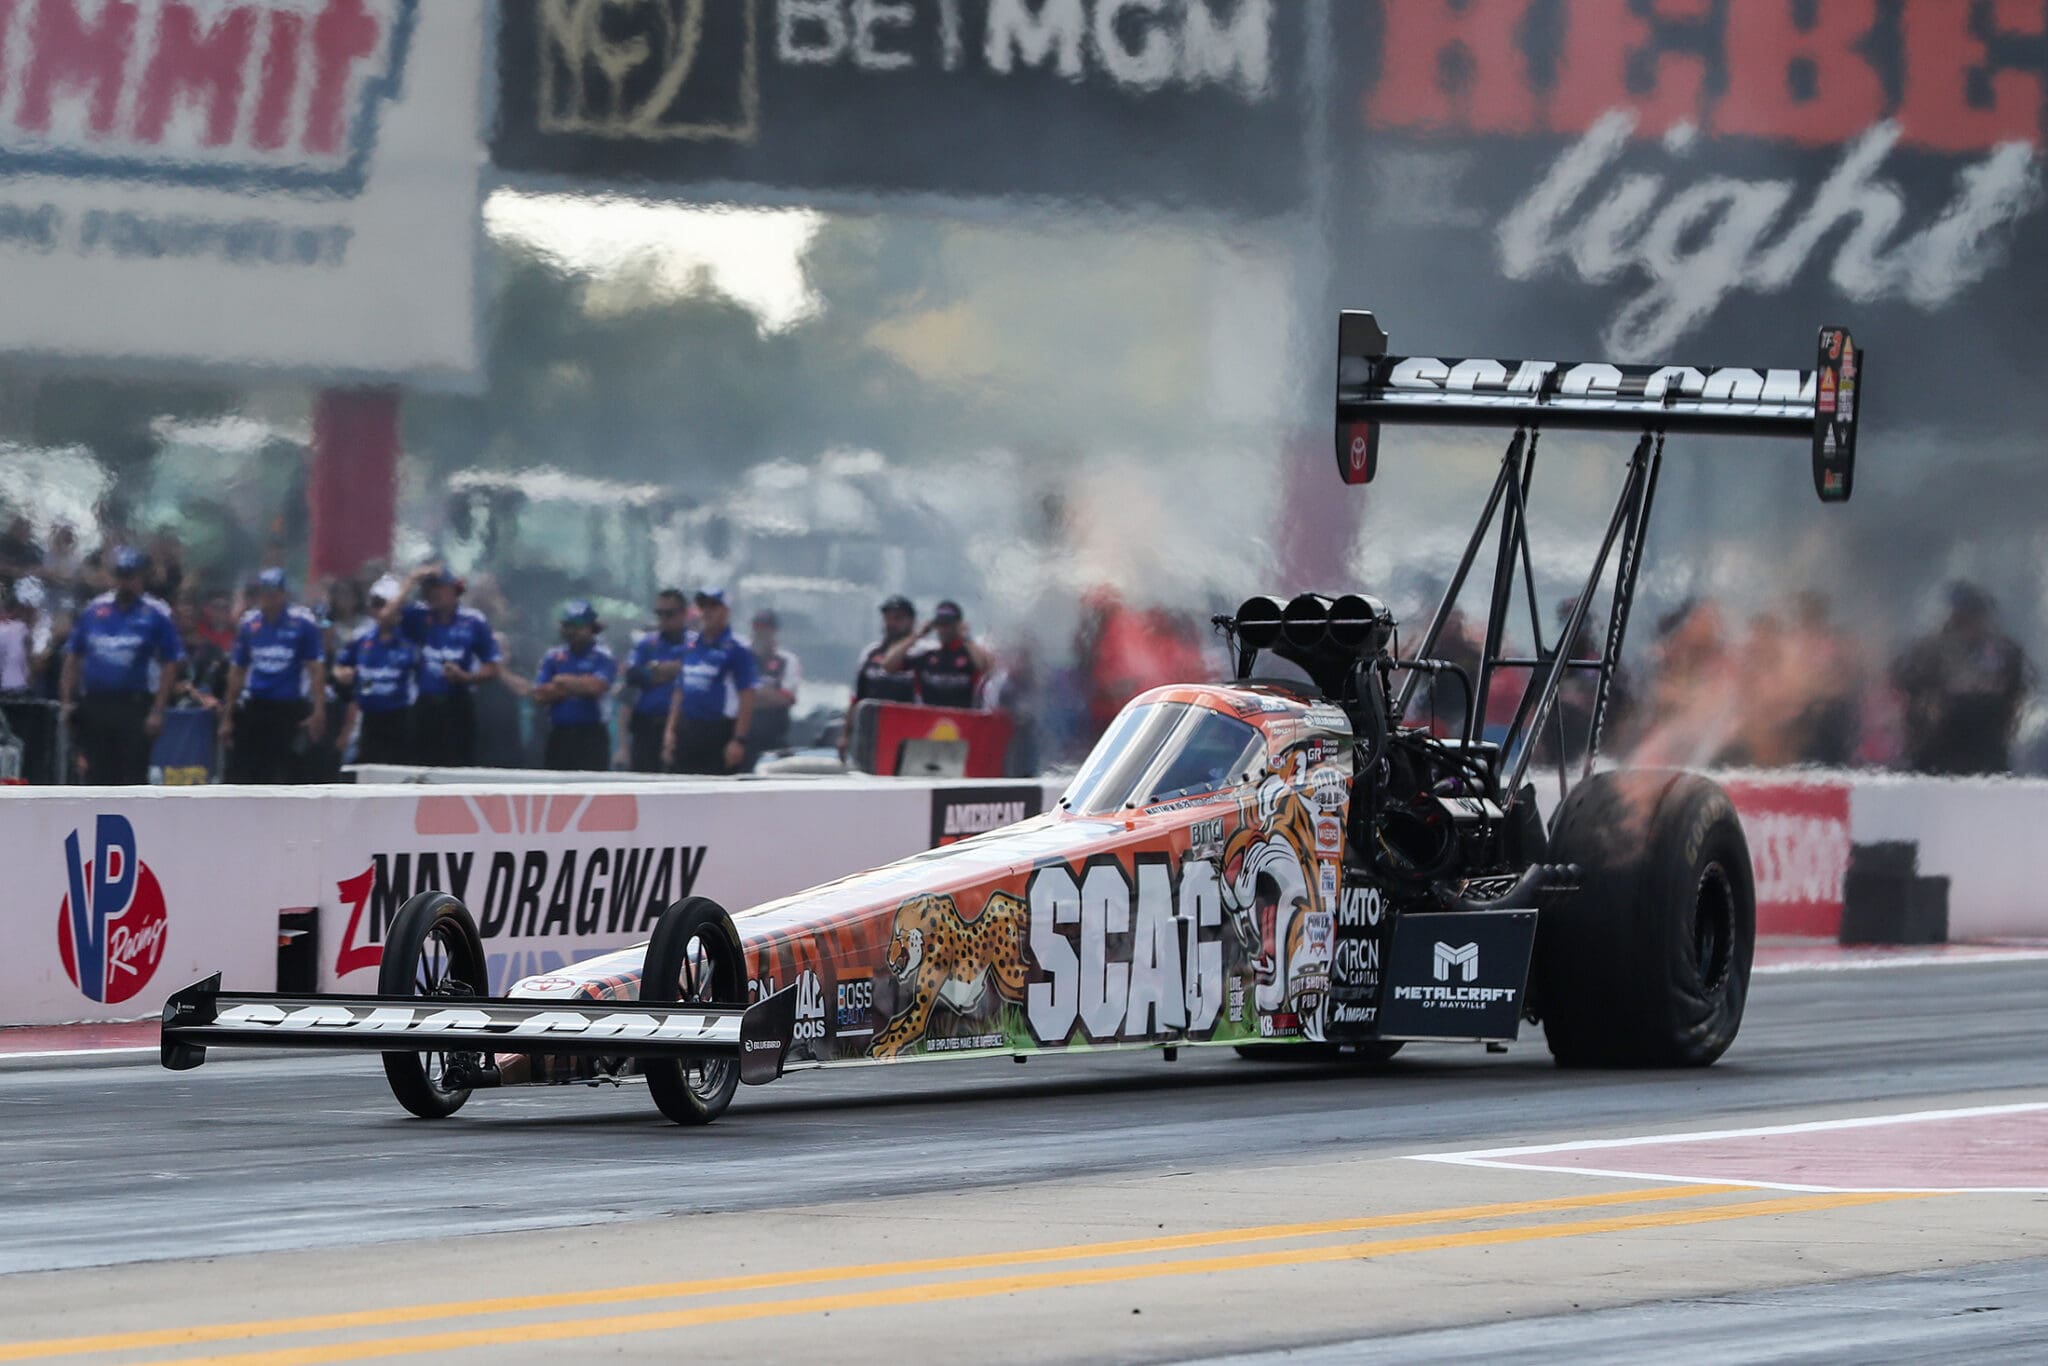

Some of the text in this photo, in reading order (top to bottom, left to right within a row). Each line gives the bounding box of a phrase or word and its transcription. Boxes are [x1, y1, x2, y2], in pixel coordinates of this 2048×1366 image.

[1307, 748, 1322, 761] GR
[944, 801, 1025, 835] AMERICAN
[479, 846, 708, 939] DRAGWAY
[1340, 888, 1380, 926] KATO
[64, 815, 137, 1003] VP
[110, 914, 168, 984] Racing
[1028, 861, 1222, 1041] SCAG
[1350, 939, 1379, 969] RCN
[1350, 971, 1379, 984] CAPITAL
[837, 981, 873, 1009] BOSS
[1395, 986, 1516, 1002] METALCRAFT
[1423, 1000, 1487, 1009] OF MAYVILLE
[793, 1020, 826, 1039] OOLS
[1260, 1015, 1274, 1036] KB
